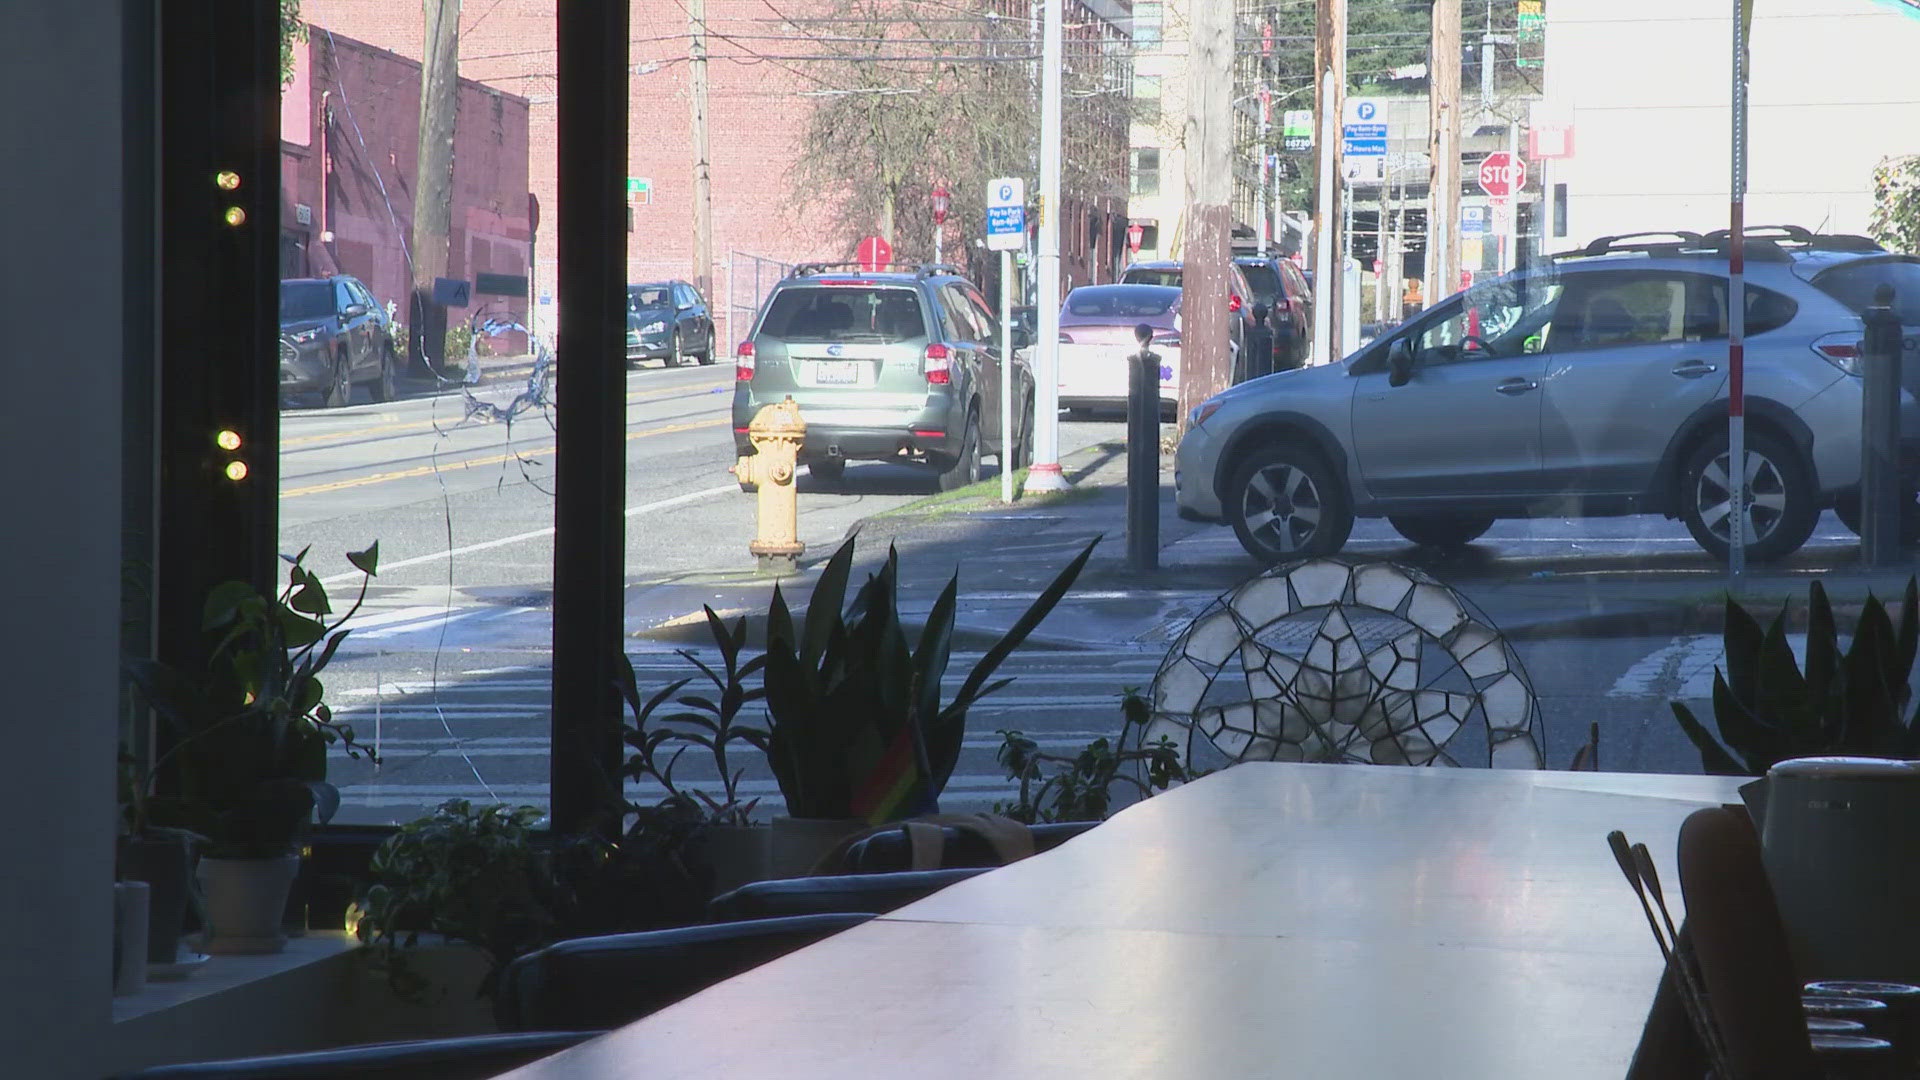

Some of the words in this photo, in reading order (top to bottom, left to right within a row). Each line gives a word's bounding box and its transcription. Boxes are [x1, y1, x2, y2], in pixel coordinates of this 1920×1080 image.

[1362, 104, 1372, 118] P
[1346, 126, 1357, 134] Pay
[1346, 143, 1353, 153] 2
[1353, 145, 1371, 153] Hours
[1371, 144, 1384, 153] Max
[1002, 187, 1010, 199] P
[989, 209, 1000, 219] Pay
[1007, 208, 1021, 216] Park
